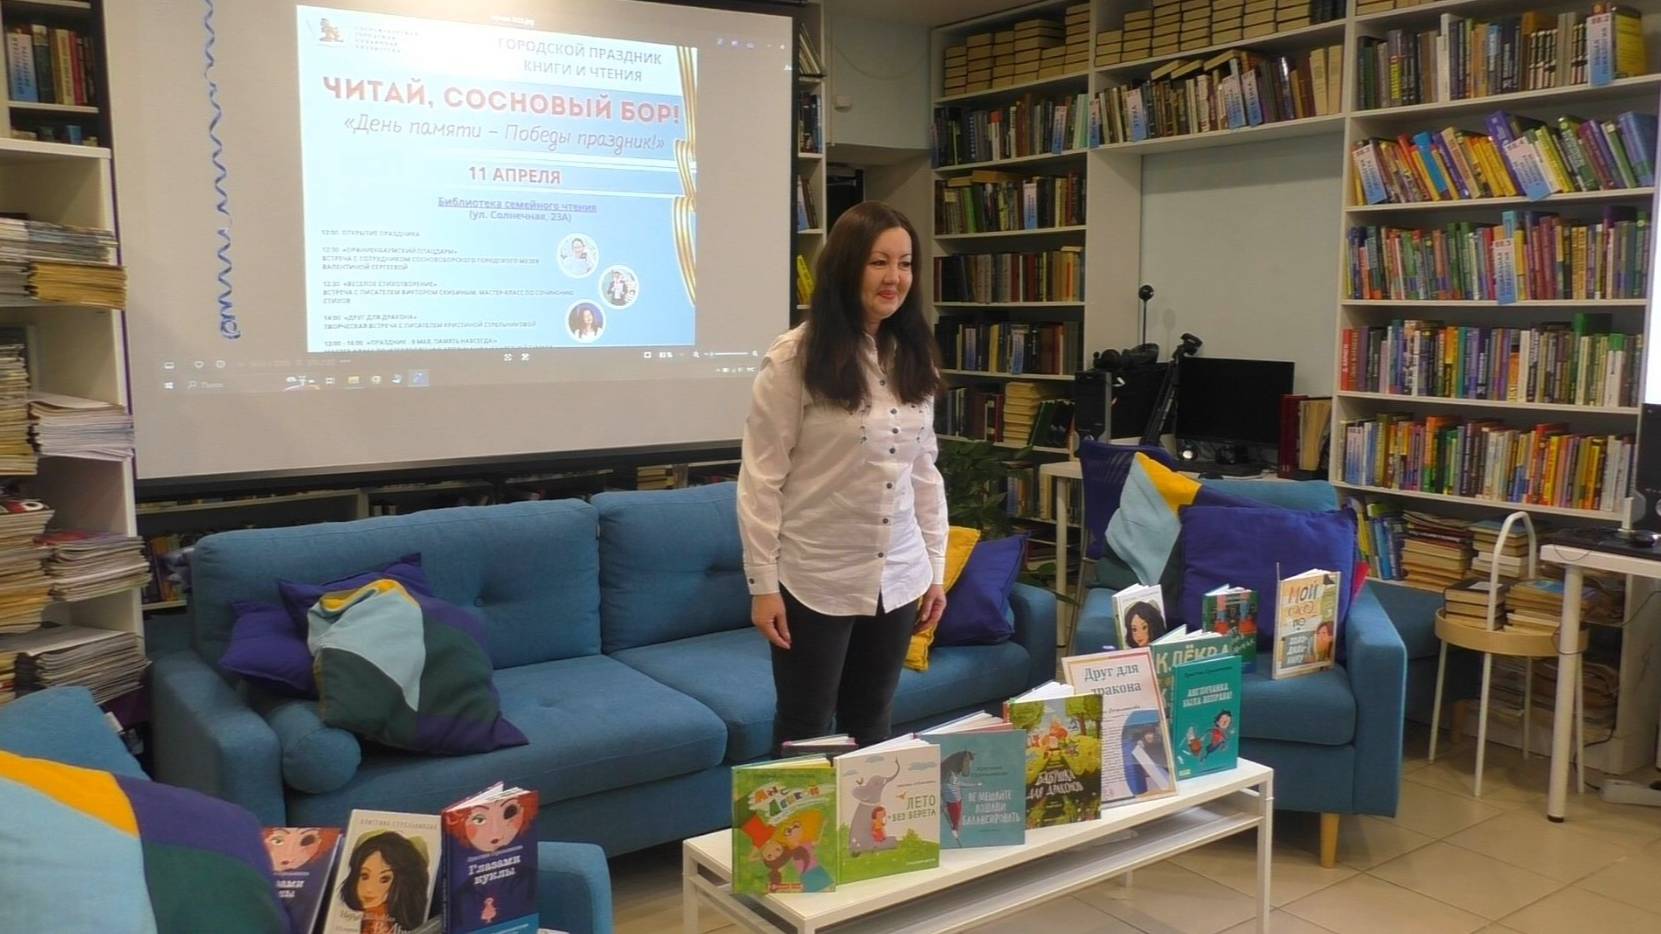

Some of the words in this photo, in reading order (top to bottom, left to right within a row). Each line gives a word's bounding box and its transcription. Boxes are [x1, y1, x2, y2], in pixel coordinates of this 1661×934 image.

[498, 37, 585, 57] ГОРОДСКОЙ
[588, 46, 662, 65] ПРАЗДНИК
[523, 59, 572, 76] КНИГИ
[576, 64, 586, 77] И
[590, 66, 643, 82] ЧТЕНИЯ
[322, 76, 435, 109] ЧИТАЙ,
[443, 85, 612, 120] СОСНОВЫЙ
[620, 100, 680, 125] БОР!
[343, 113, 403, 135] «День
[408, 121, 482, 138] памяти
[504, 124, 572, 152] Победы
[577, 132, 666, 156] праздник!»
[468, 166, 487, 181] 11
[491, 167, 561, 185] АПРЕЛЯ
[438, 196, 502, 209] Библиотека
[504, 199, 560, 212] семейного
[561, 202, 598, 214] чтения
[1084, 667, 1113, 682] Друг
[1116, 664, 1140, 678] для
[906, 794, 937, 811] ЛЕТО
[891, 810, 906, 822] БЕЗ
[908, 808, 937, 821] БЕРЕТА
[467, 855, 521, 876] Глазами
[472, 867, 517, 885] куклы
